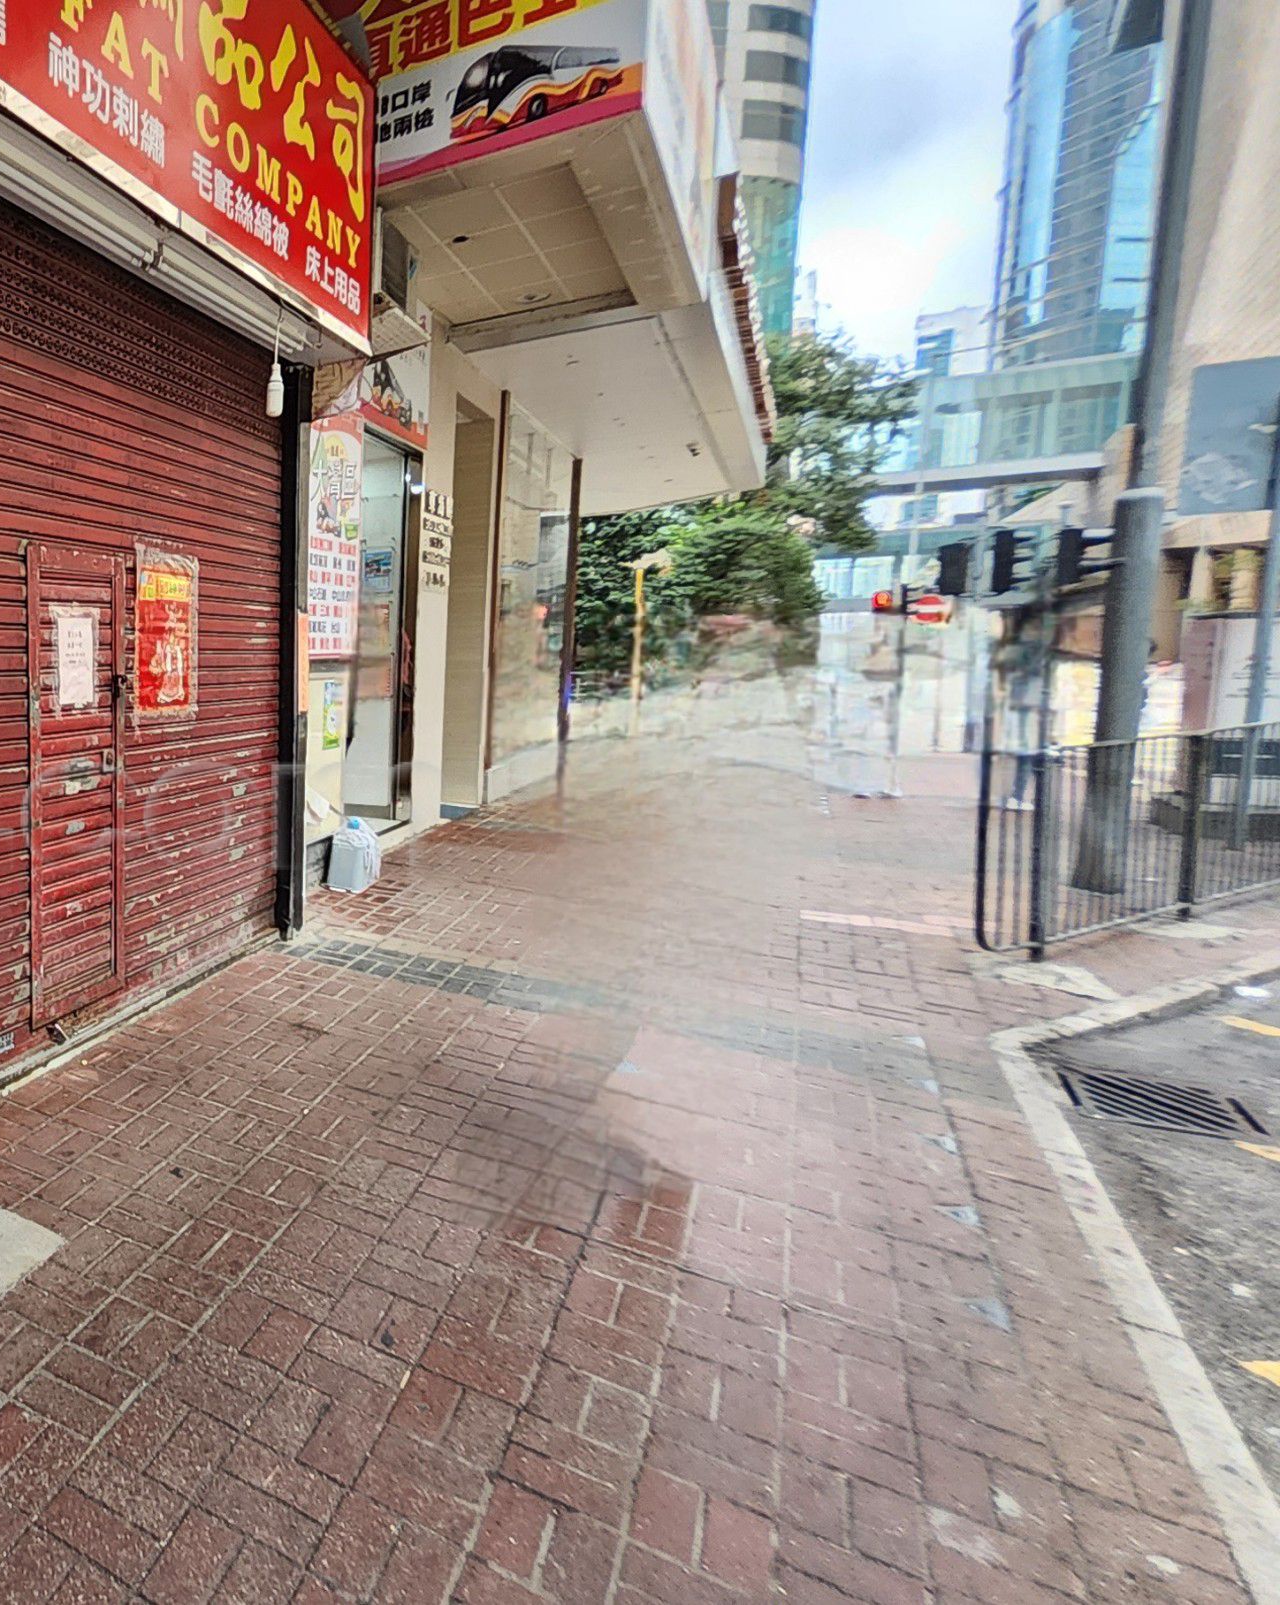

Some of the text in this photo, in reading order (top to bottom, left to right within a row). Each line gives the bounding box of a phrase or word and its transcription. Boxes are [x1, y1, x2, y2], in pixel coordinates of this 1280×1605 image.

[48, 32, 165, 168] 神功刺繡
[305, 246, 361, 315] 床上用品
[195, 94, 361, 268] COMPANY
